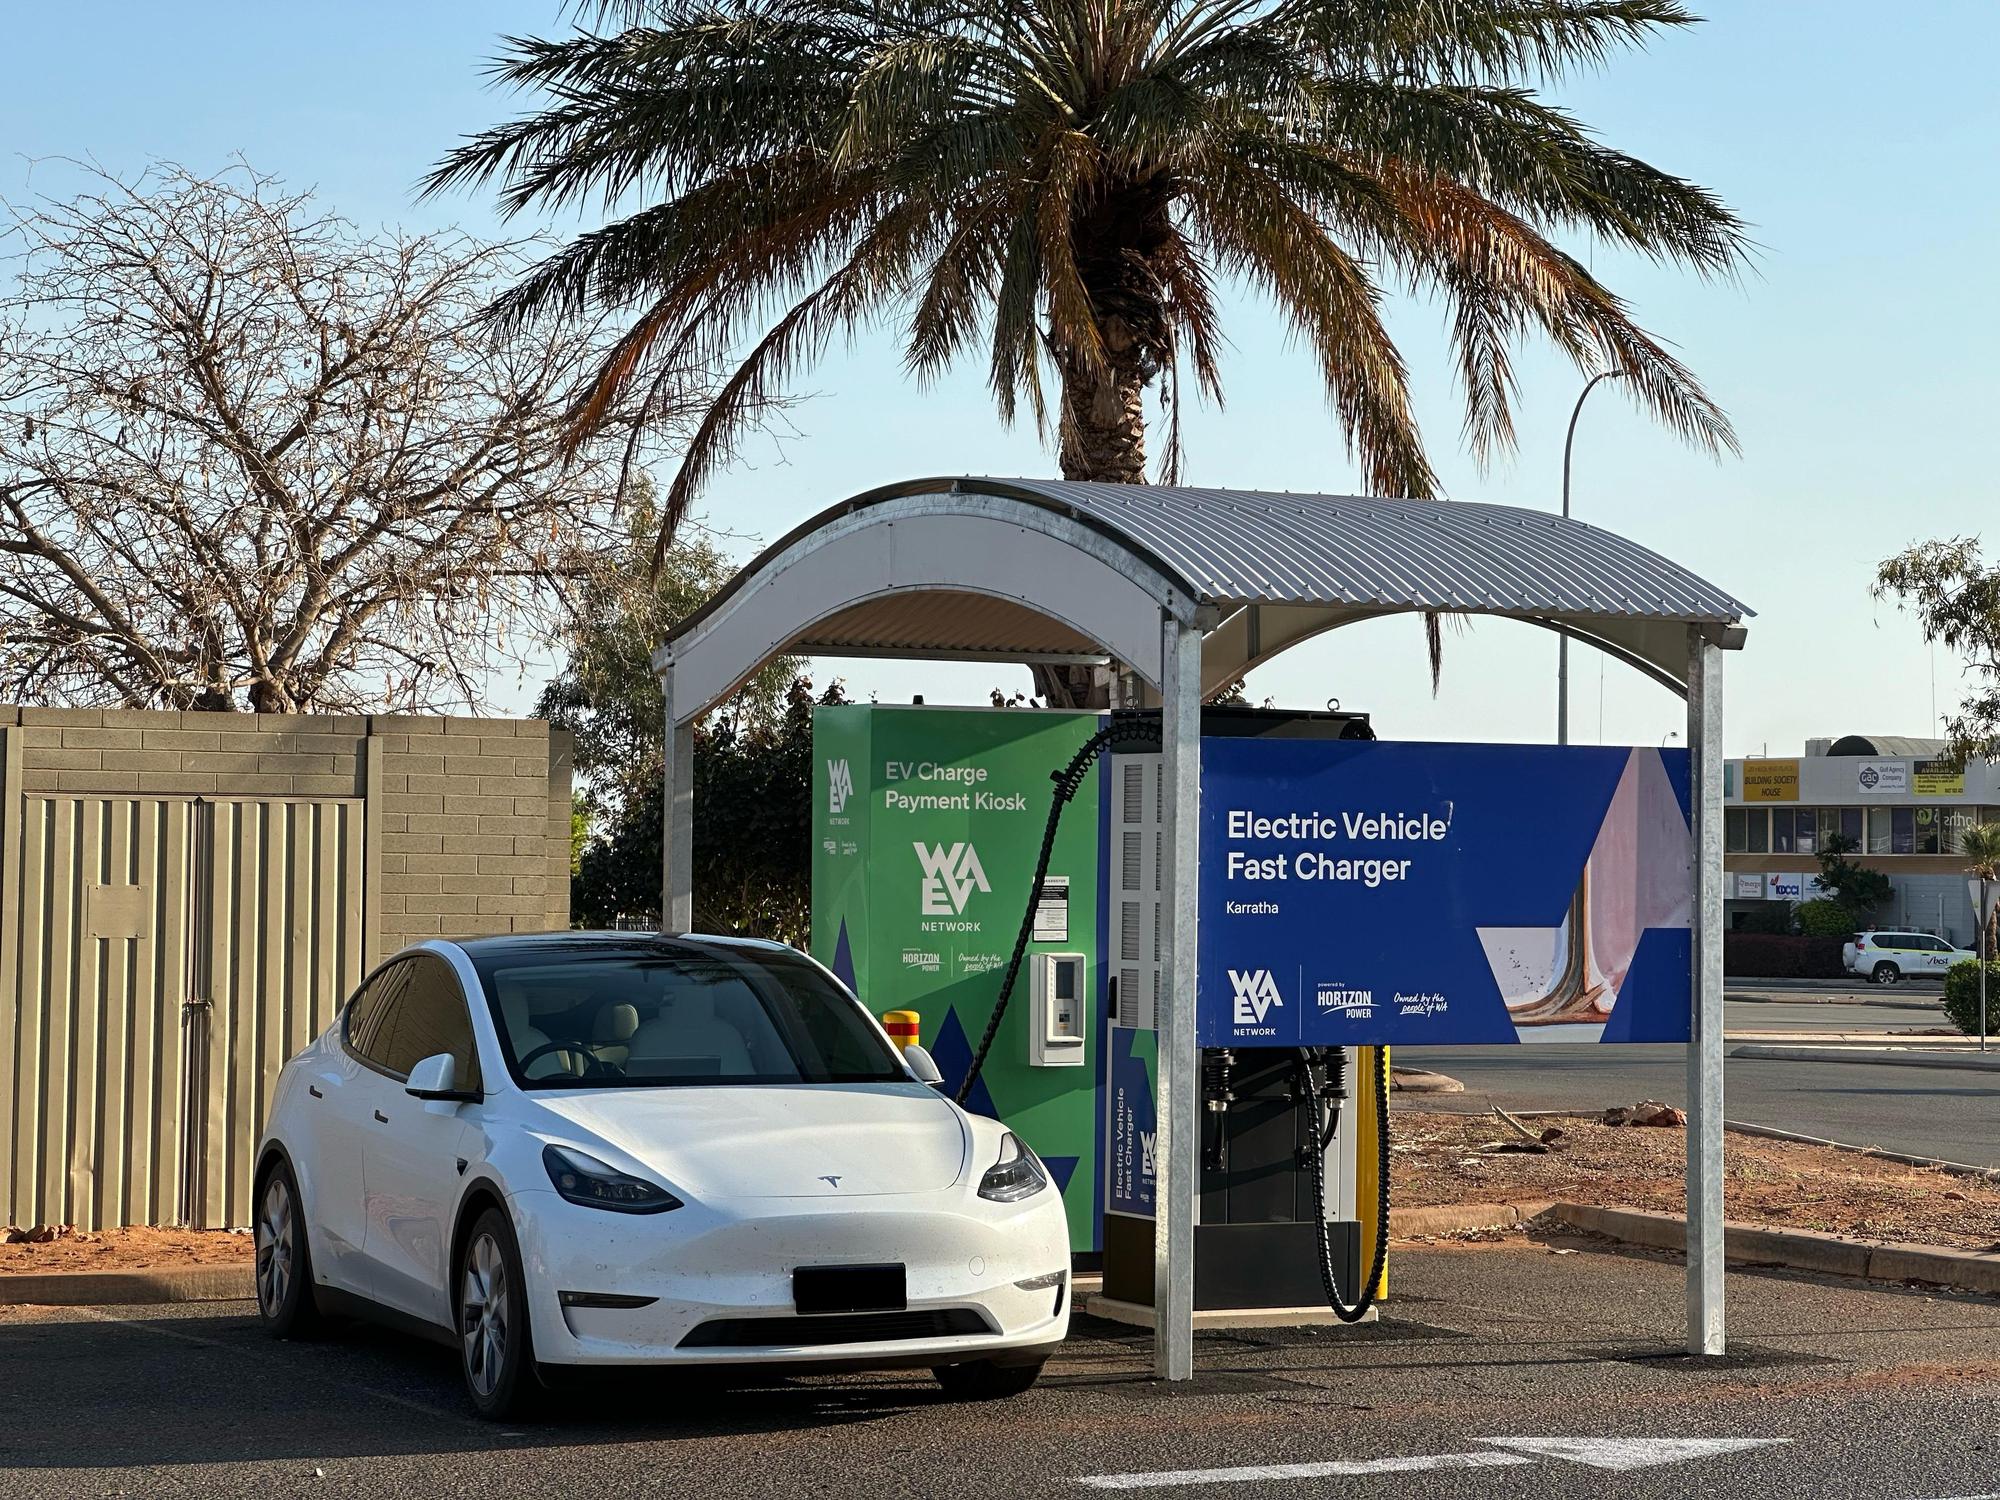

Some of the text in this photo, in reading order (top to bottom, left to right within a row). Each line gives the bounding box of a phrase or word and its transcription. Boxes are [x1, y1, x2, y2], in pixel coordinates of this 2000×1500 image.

[828, 759, 853, 795] WA
[886, 761, 988, 786] EV Charge
[1745, 775, 1798, 785] BUILDING SOCIETY
[1761, 787, 1782, 797] HOUSE
[885, 790, 1026, 813] Payment Kiosk
[1228, 810, 1447, 840] Electric Vehicle
[912, 842, 992, 892] WA
[1227, 852, 1411, 888] Fast Charger
[922, 878, 976, 915] EV
[1776, 885, 1799, 895] KDCCI
[1226, 901, 1279, 914] Karratha
[921, 922, 981, 931] NETWORK
[902, 953, 940, 964] HORIZON
[921, 964, 940, 973] POWER
[1227, 969, 1284, 1006] WA
[1317, 990, 1372, 1007] HORIZON
[1393, 991, 1419, 1004] Owned
[1420, 993, 1431, 1007] by
[1234, 996, 1272, 1024] EV
[1346, 1008, 1372, 1019] POWER
[1400, 1002, 1425, 1015] people
[1233, 1028, 1276, 1036] NETWORK
[1116, 1087, 1125, 1199] Electric Vehicle
[1124, 1106, 1134, 1200] Fast Charger
